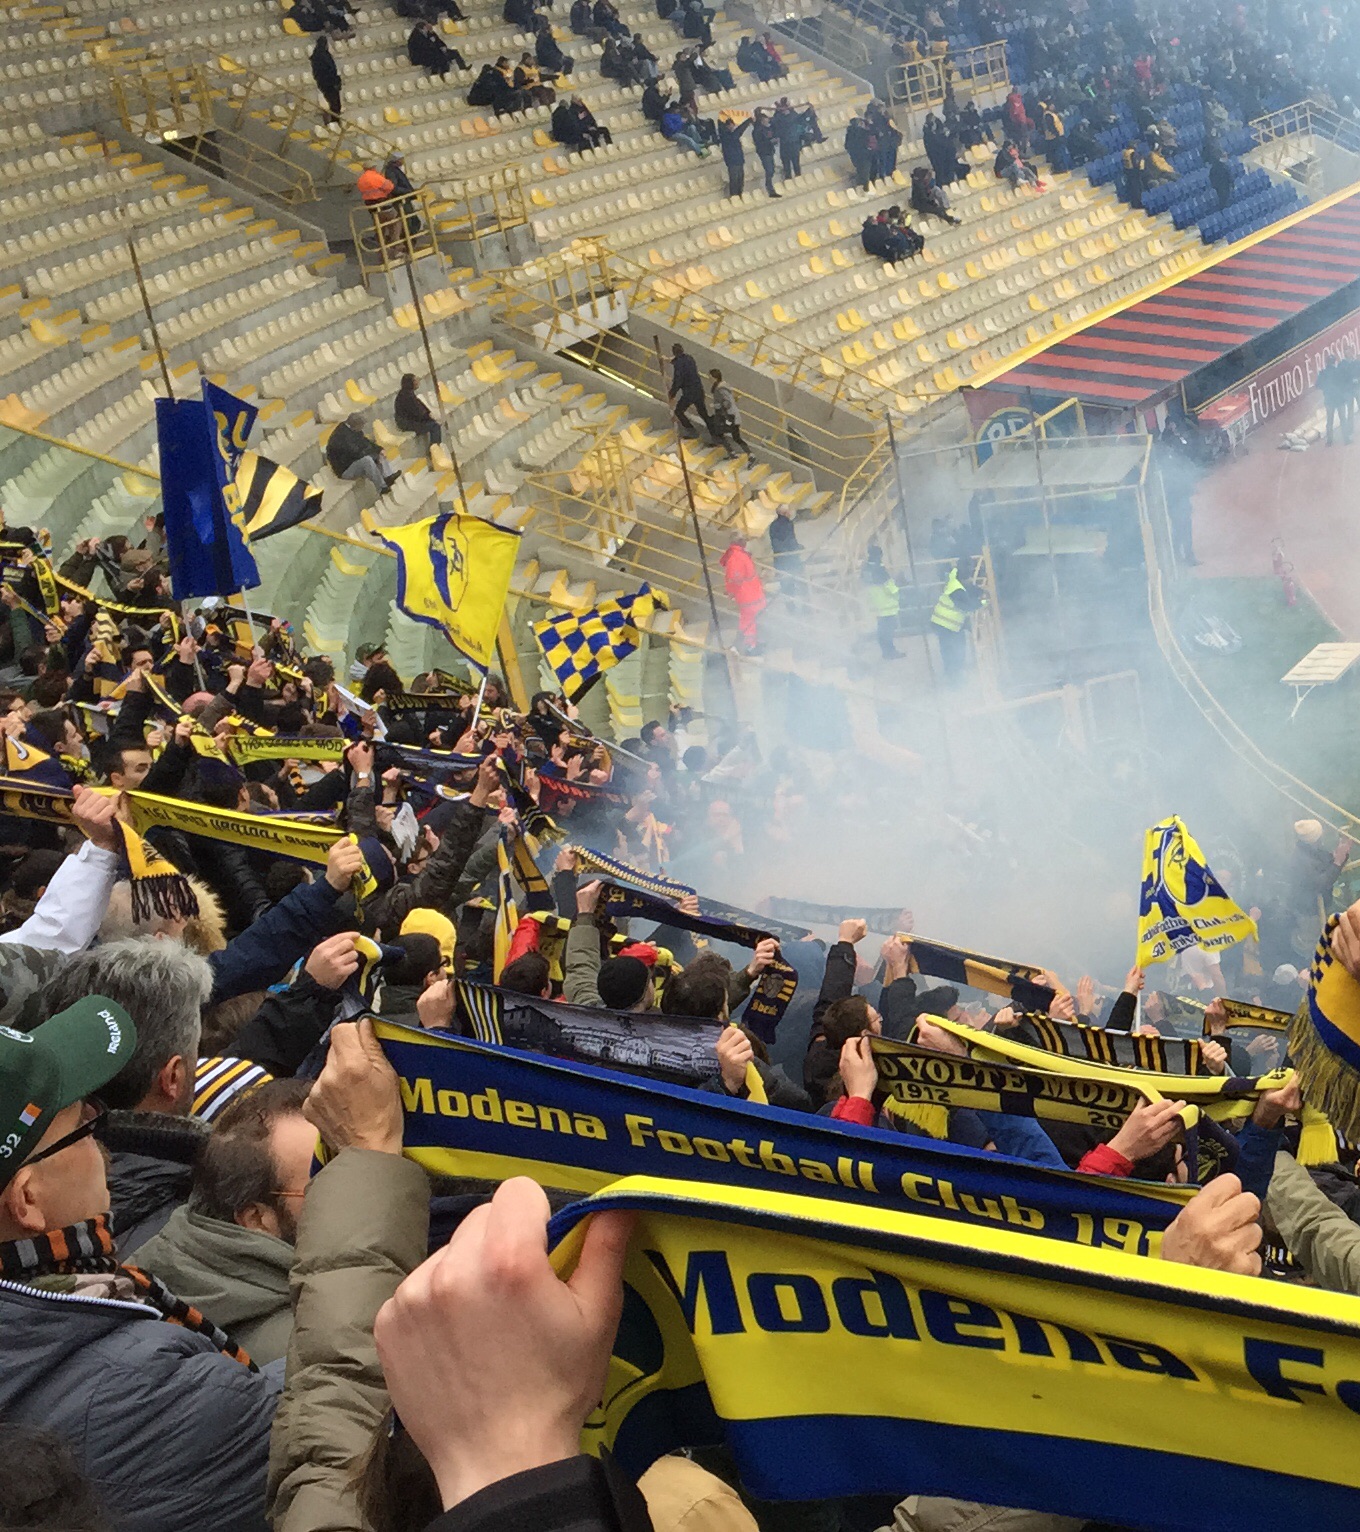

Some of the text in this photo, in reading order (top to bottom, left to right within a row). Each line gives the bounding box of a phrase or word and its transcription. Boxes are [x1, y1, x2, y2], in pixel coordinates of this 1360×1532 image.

[1248, 366, 1305, 424] FUTURO
[894, 1082, 951, 1103] 1912
[897, 1056, 1029, 1094] VOLTE
[400, 1076, 608, 1142] Modena
[624, 1113, 880, 1194] Football
[900, 1171, 1045, 1231] Club
[645, 1248, 1202, 1384] Modena
